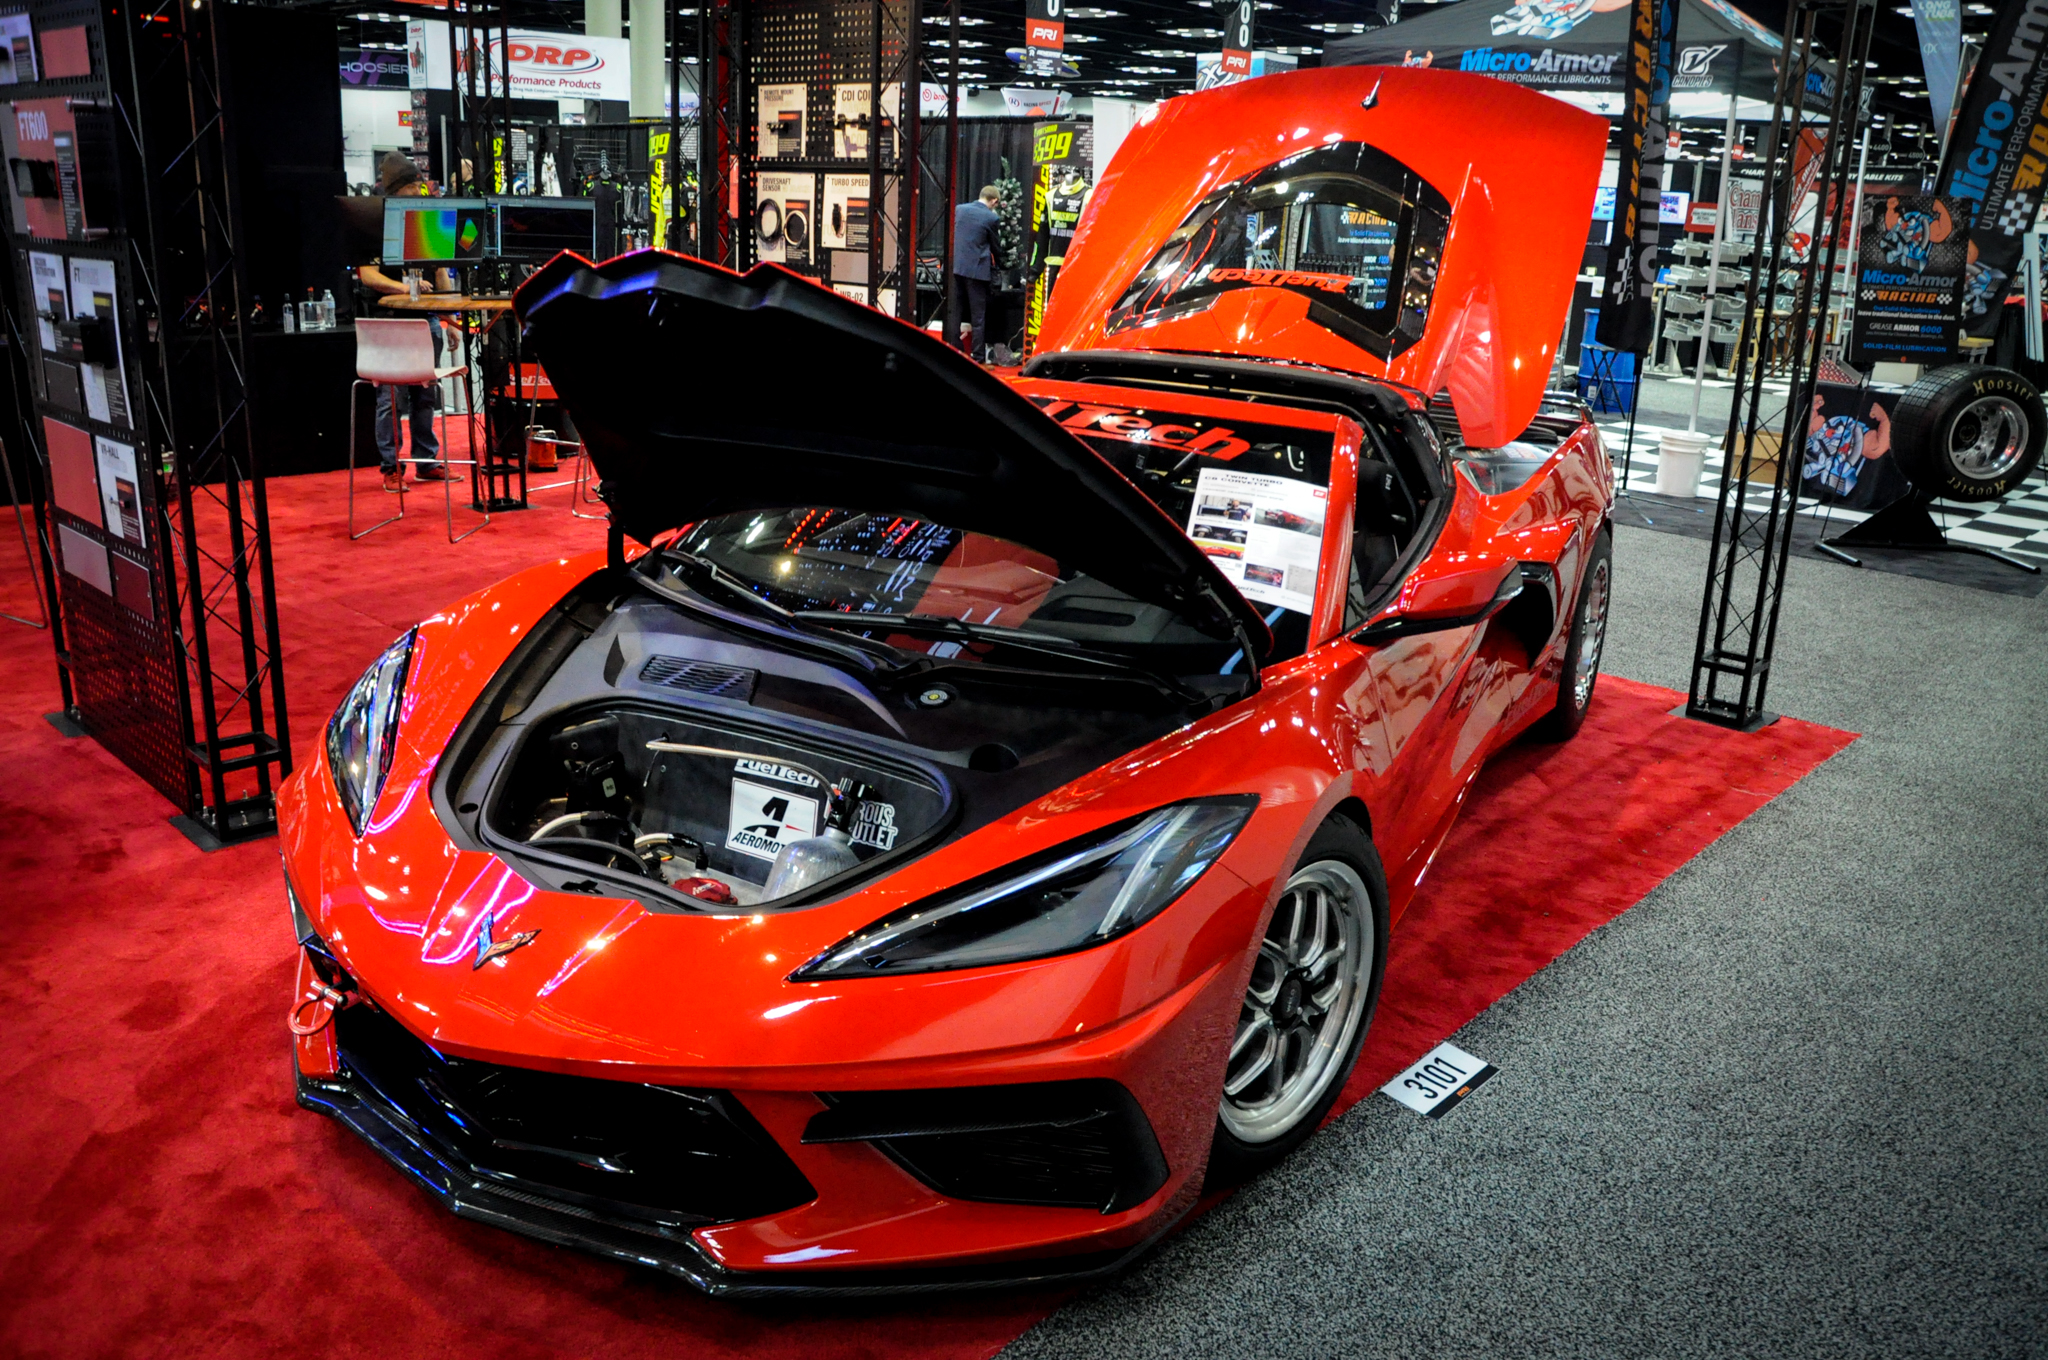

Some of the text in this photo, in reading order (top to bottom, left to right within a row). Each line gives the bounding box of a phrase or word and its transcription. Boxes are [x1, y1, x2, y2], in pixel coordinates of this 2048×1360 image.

[1032, 27, 1058, 41] PRI
[507, 43, 591, 66] DRP
[1226, 55, 1247, 68] PRI
[1460, 47, 1617, 73] Micro-Armor
[491, 74, 556, 87] Peformance
[558, 78, 602, 90] Products
[1497, 73, 1558, 84] PERFORMANCE
[1559, 74, 1611, 85] LUBRICANTS
[842, 90, 871, 101] CDI COI
[17, 110, 49, 141] FT600
[1033, 132, 1073, 162] $599
[831, 178, 869, 187] TURBO SPEED
[1979, 163, 2014, 230] ULTIMATE
[1862, 269, 1957, 287] Micro-Armor
[1876, 290, 1937, 303] RACING
[1869, 322, 1942, 334] GREASE ARMOR 6000
[1863, 342, 1947, 353] SOLID-FILM LUBRICATION
[1972, 379, 2034, 400] Hoosier
[1252, 477, 1283, 485] TURBO
[734, 758, 819, 788] FuelTech
[731, 831, 786, 854] AEROMOT
[852, 823, 898, 850] UTLET
[1403, 1057, 1467, 1099] 3101
